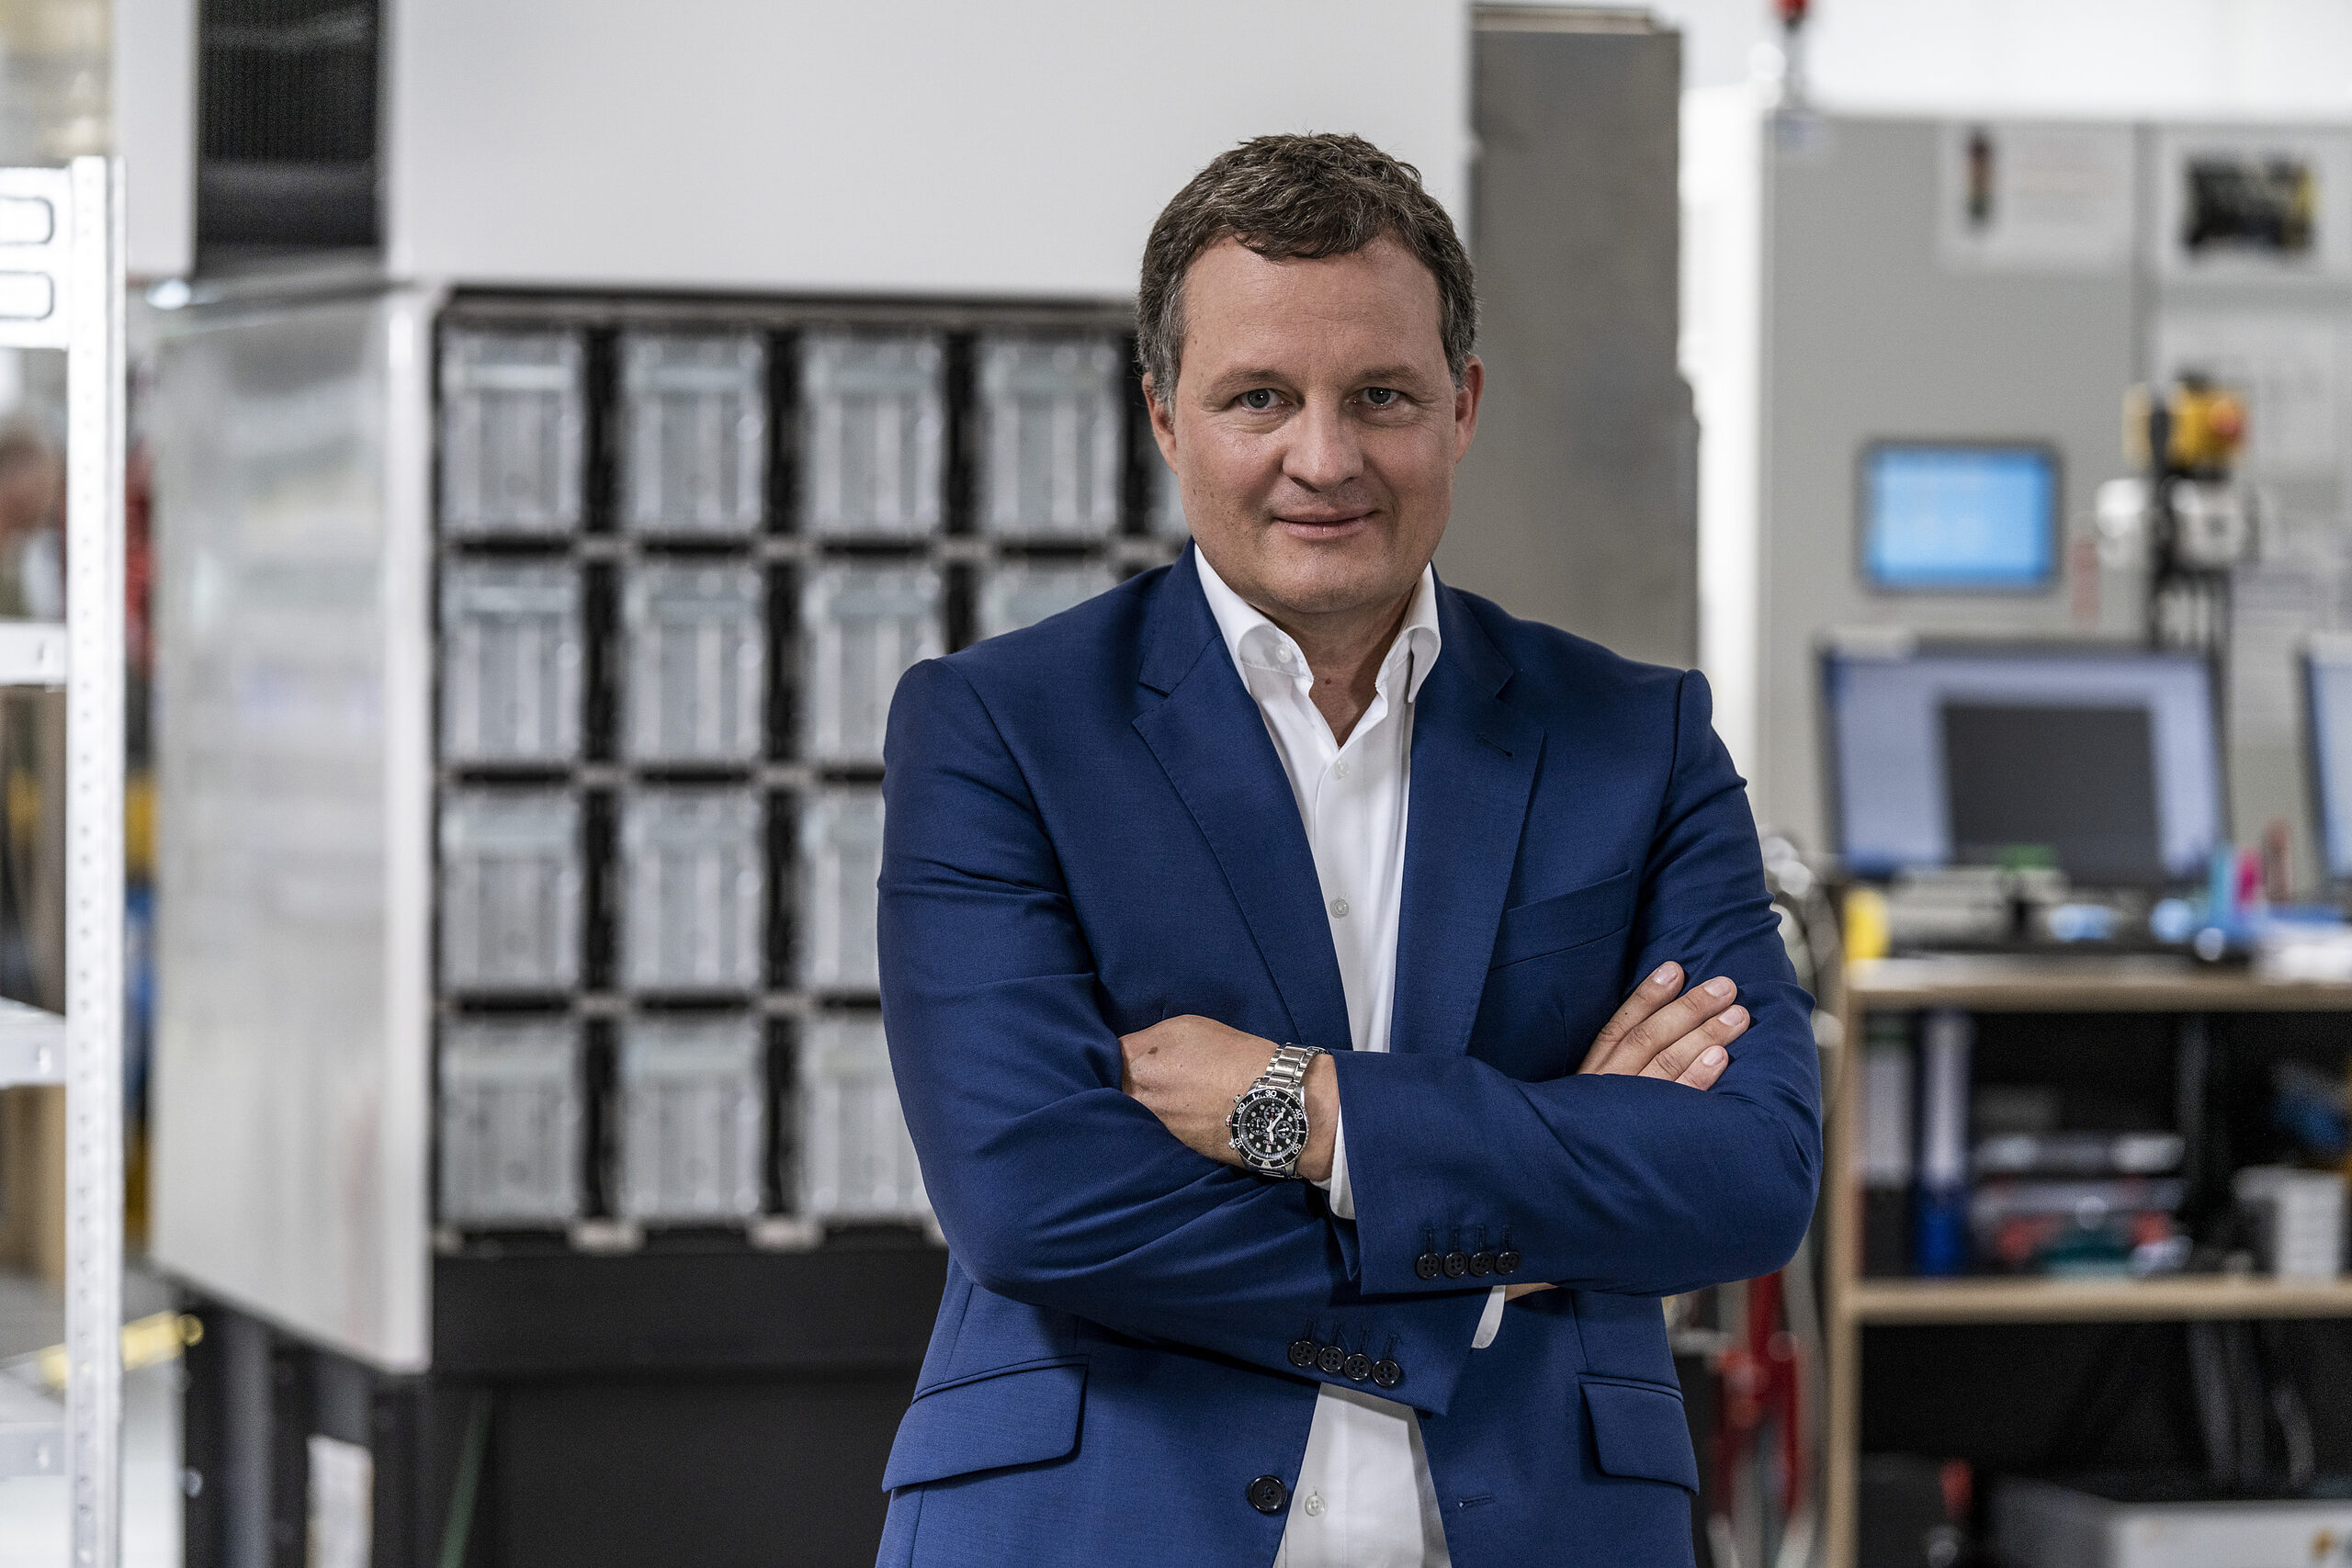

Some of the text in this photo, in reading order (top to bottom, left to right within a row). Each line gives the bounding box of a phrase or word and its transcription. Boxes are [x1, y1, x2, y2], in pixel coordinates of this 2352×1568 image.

[1236, 1102, 1245, 1113] 20
[1295, 1108, 1304, 1120] 40
[1292, 1143, 1302, 1155] 50
